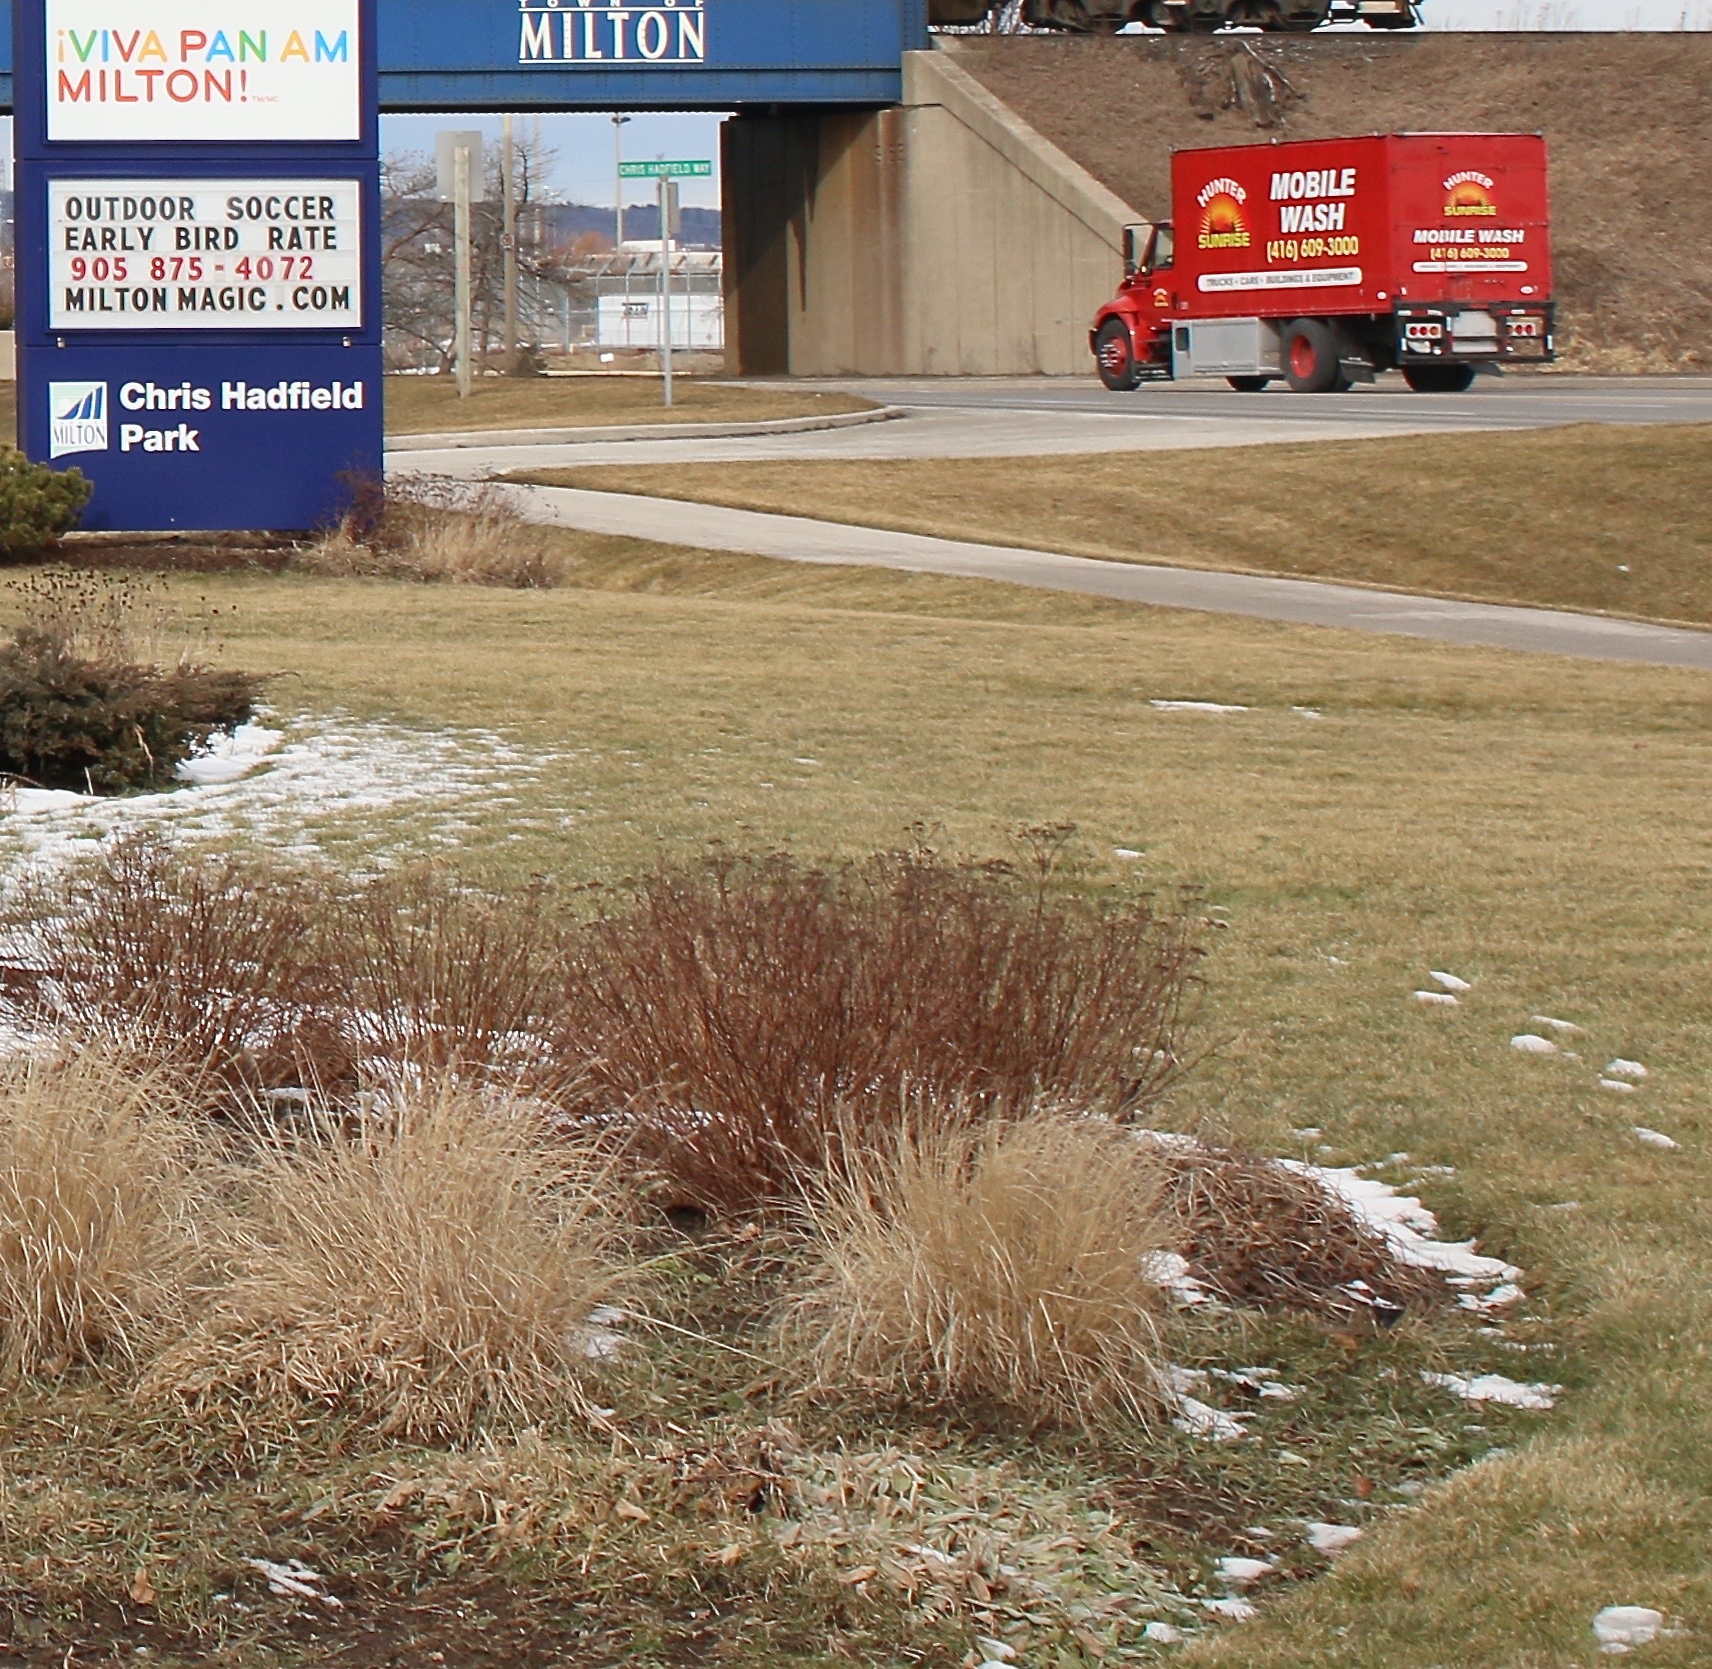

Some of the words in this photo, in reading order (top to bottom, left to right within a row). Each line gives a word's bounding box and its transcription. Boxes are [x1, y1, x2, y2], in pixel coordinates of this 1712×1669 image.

[179, 29, 267, 63] PAN
[280, 29, 348, 63] AM
[519, 11, 704, 59] MILTON
[57, 69, 248, 103] MILTON!
[1197, 177, 1247, 208] HUNTER
[1270, 168, 1356, 200] MOBILE
[1443, 171, 1494, 191] HUNTER
[64, 196, 195, 221] OUTDOOR
[226, 196, 335, 220] SOCCER
[1280, 202, 1346, 233] WASH
[1444, 206, 1496, 216] SUNRISE
[65, 226, 154, 251] EARLY
[175, 226, 239, 250] BIRD
[268, 226, 337, 250] RATE
[1198, 232, 1250, 249] SUNRISE
[1413, 229, 1476, 243] MOBILE
[1478, 229, 1525, 243] WASH
[1267, 239, 1298, 263] (416)
[1300, 236, 1359, 258] 609-3000
[1430, 247, 1458, 260] (416)
[1460, 247, 1510, 259] 609-3000
[70, 256, 128, 281] 905
[119, 381, 211, 410] Chris
[222, 381, 363, 410] Hadfield
[52, 425, 106, 444] MILTON
[120, 423, 200, 452] Park
